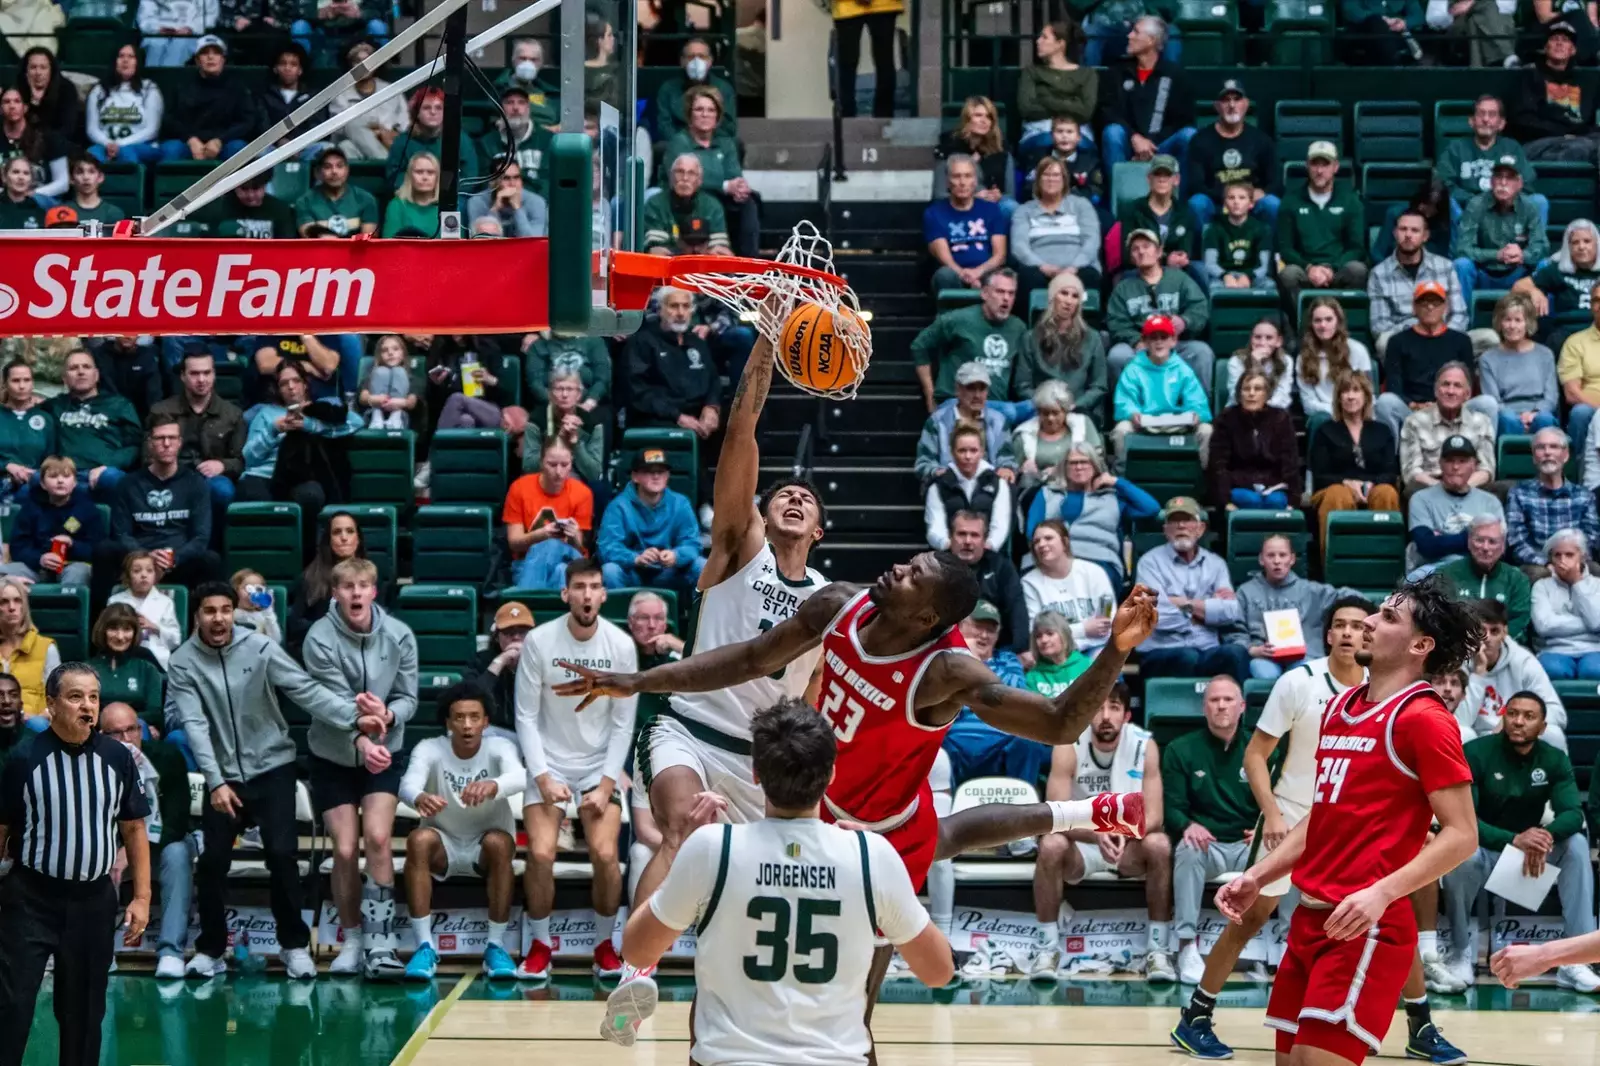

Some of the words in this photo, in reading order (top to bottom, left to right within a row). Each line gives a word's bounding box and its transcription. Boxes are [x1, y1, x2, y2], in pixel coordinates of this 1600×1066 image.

[789, 321, 809, 377] Wilson
[818, 334, 833, 374] NCAA
[753, 580, 806, 609] COLOR
[763, 599, 797, 618] STAT
[825, 648, 848, 677] NEW
[844, 668, 896, 711] MEXICO
[821, 680, 865, 743] 23
[1332, 735, 1377, 753] MEXICO
[1077, 775, 1110, 785] COLOR
[1088, 783, 1111, 792] STAT
[1314, 757, 1351, 804] 24
[964, 788, 1027, 797] COLORADO
[979, 796, 1014, 804] STATE
[756, 863, 836, 889] JORGENSEN
[224, 908, 276, 931] Peders
[431, 912, 488, 932] Peders
[549, 918, 597, 933] ederse
[1072, 914, 1146, 933] edersen
[1494, 919, 1565, 940] Pederse
[249, 936, 276, 945] TOYO
[461, 937, 488, 946] TOYO
[564, 938, 595, 946] TOYO
[742, 895, 841, 984] 35
[1089, 938, 1133, 948] TOYOTA
